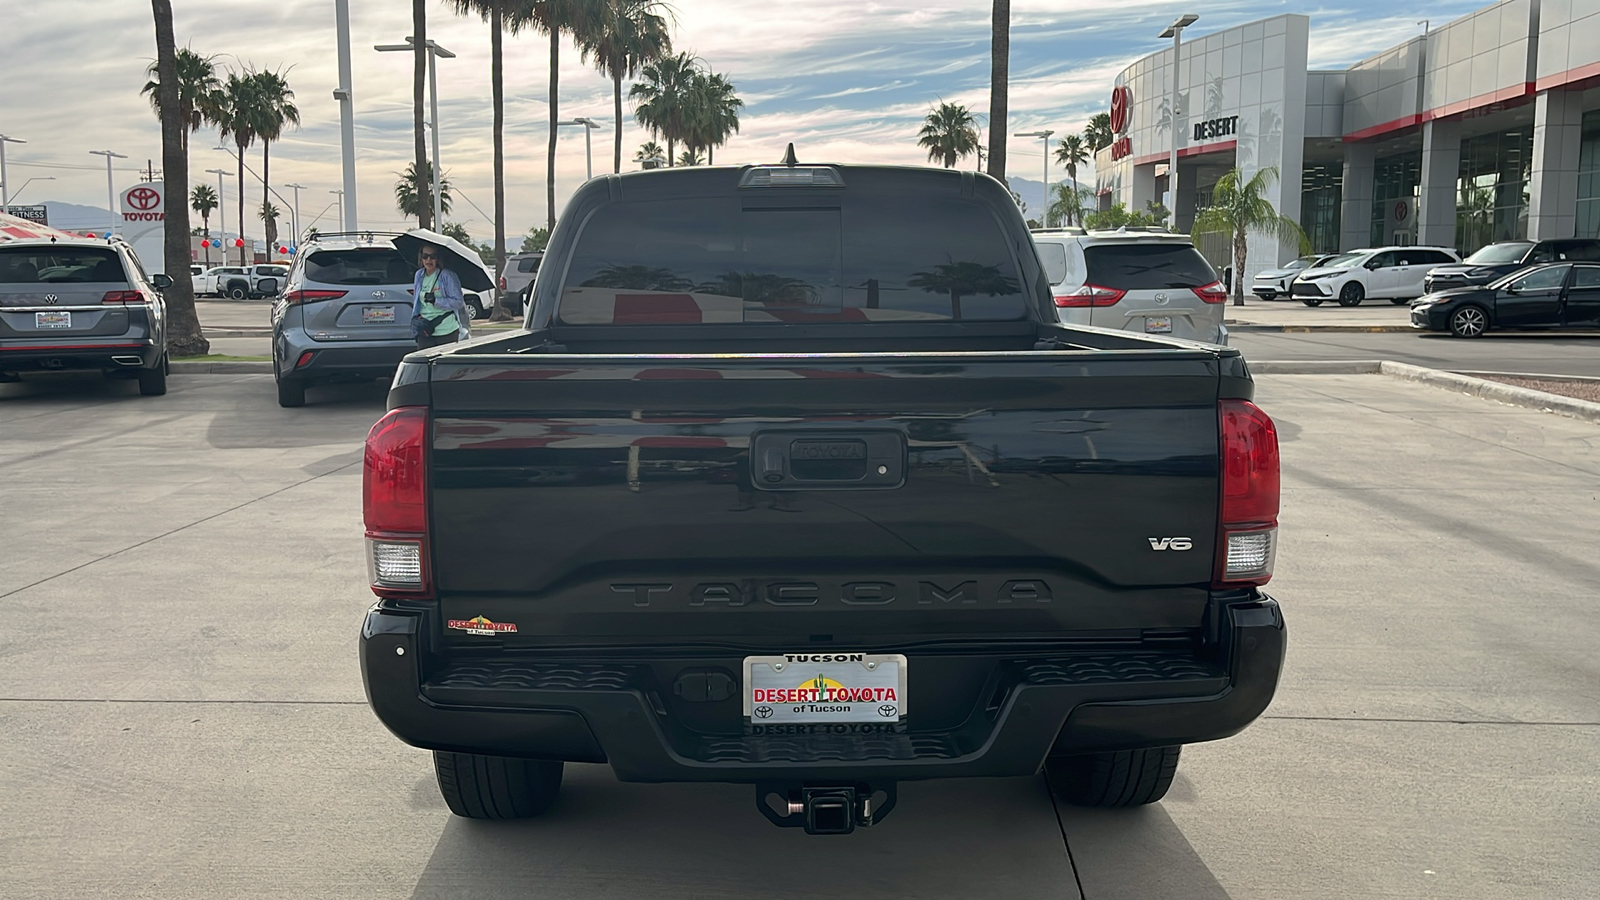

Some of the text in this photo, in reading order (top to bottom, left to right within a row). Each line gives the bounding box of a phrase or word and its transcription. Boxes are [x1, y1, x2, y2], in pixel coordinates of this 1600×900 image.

[1194, 115, 1239, 141] DESERT
[802, 445, 862, 458] TOYOTA
[1148, 537, 1192, 550] V6
[610, 579, 1053, 607] TACOMA
[448, 620, 517, 632] DESERT TOYOTA
[785, 654, 863, 663] TUCSON
[754, 687, 896, 703] DESERT TOYOTA
[793, 704, 851, 713] of Tucson
[752, 724, 896, 736] DESERT TOYOTA
